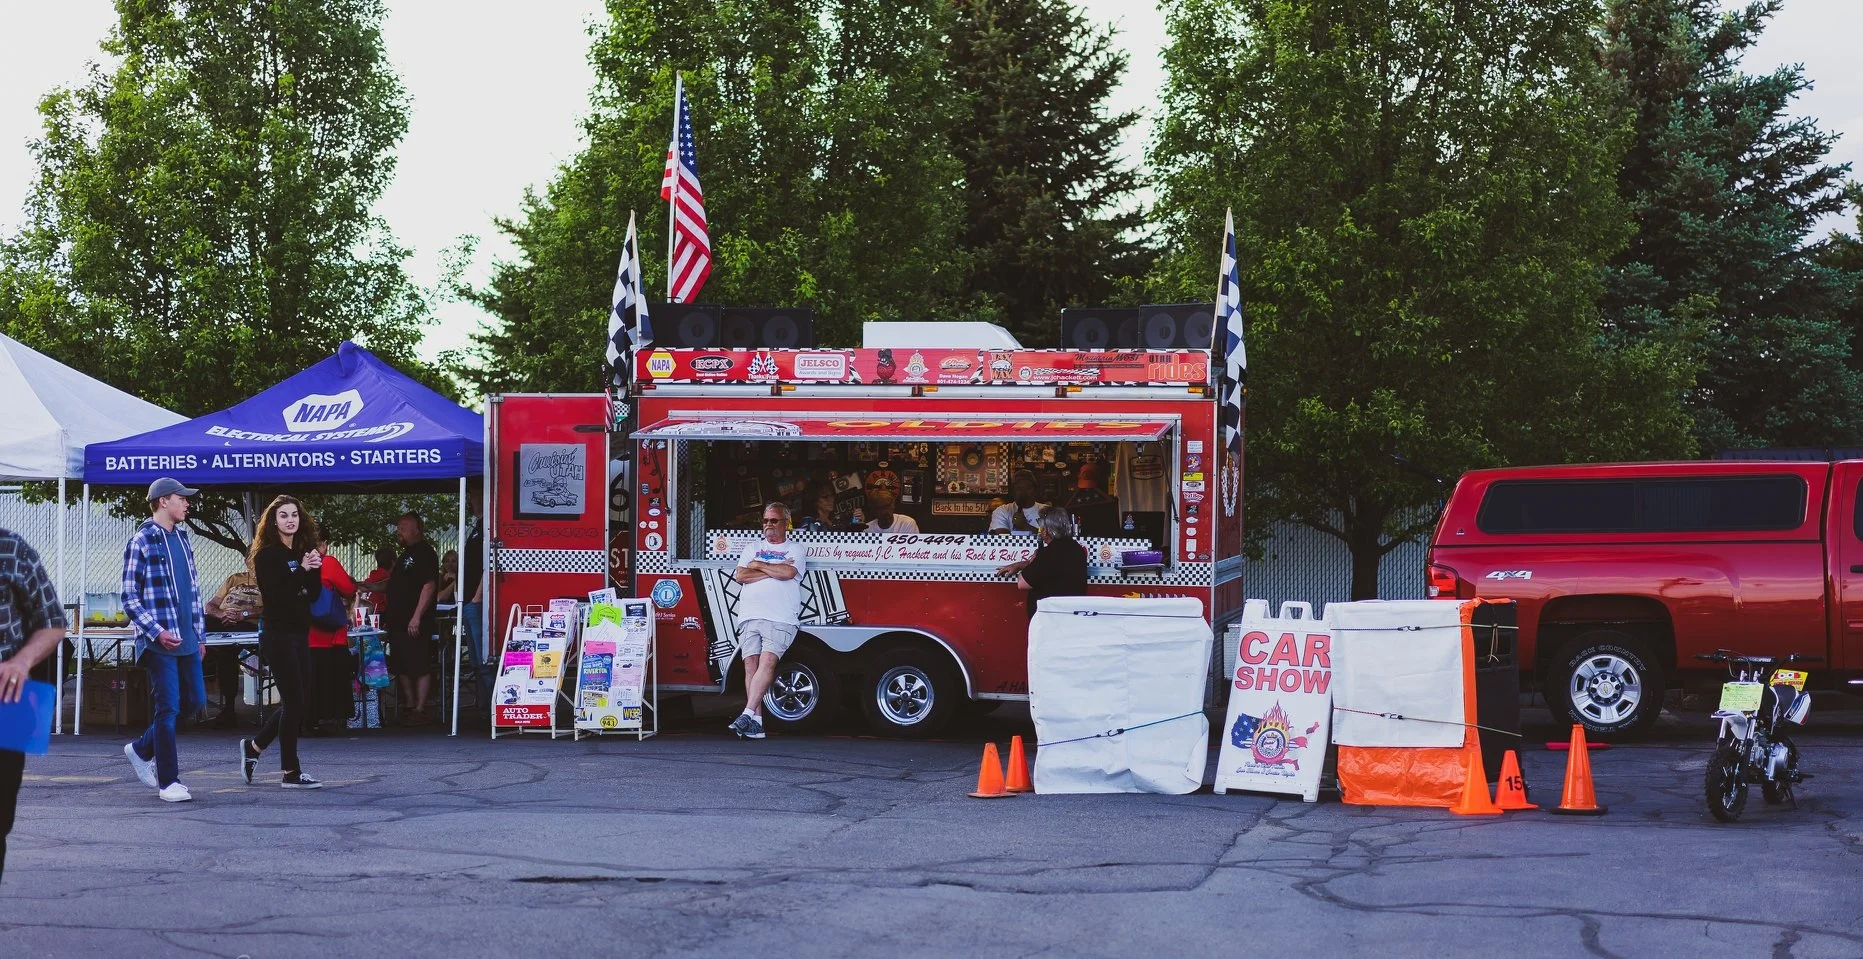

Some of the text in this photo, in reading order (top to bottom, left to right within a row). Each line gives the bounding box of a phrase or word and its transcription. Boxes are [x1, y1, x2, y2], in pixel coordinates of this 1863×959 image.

[652, 359, 671, 371] NAPA
[800, 359, 840, 368] JELSCO
[1148, 353, 1207, 381] rides
[292, 400, 353, 424] NAPA
[205, 421, 399, 444] ELECTRICAL SYSTEMS
[827, 420, 1144, 429] OLDIES
[105, 448, 442, 471] BATTERIES ALTERNATORS STARTERS
[550, 463, 584, 481] UTAH
[935, 502, 953, 512] Back
[954, 503, 961, 512] to
[962, 502, 974, 512] the
[886, 534, 966, 546] 450-4494
[806, 546, 832, 558] DIES
[833, 545, 843, 560] by
[875, 545, 894, 562] J.C.
[898, 546, 931, 560] Hackett
[932, 549, 949, 560] and
[950, 548, 962, 560] his
[965, 548, 988, 561] Rock
[989, 548, 996, 560] &
[998, 548, 1019, 562] Roll
[1239, 630, 1332, 669] CAR
[1234, 666, 1332, 695] SHOW
[1505, 775, 1523, 791] 15
